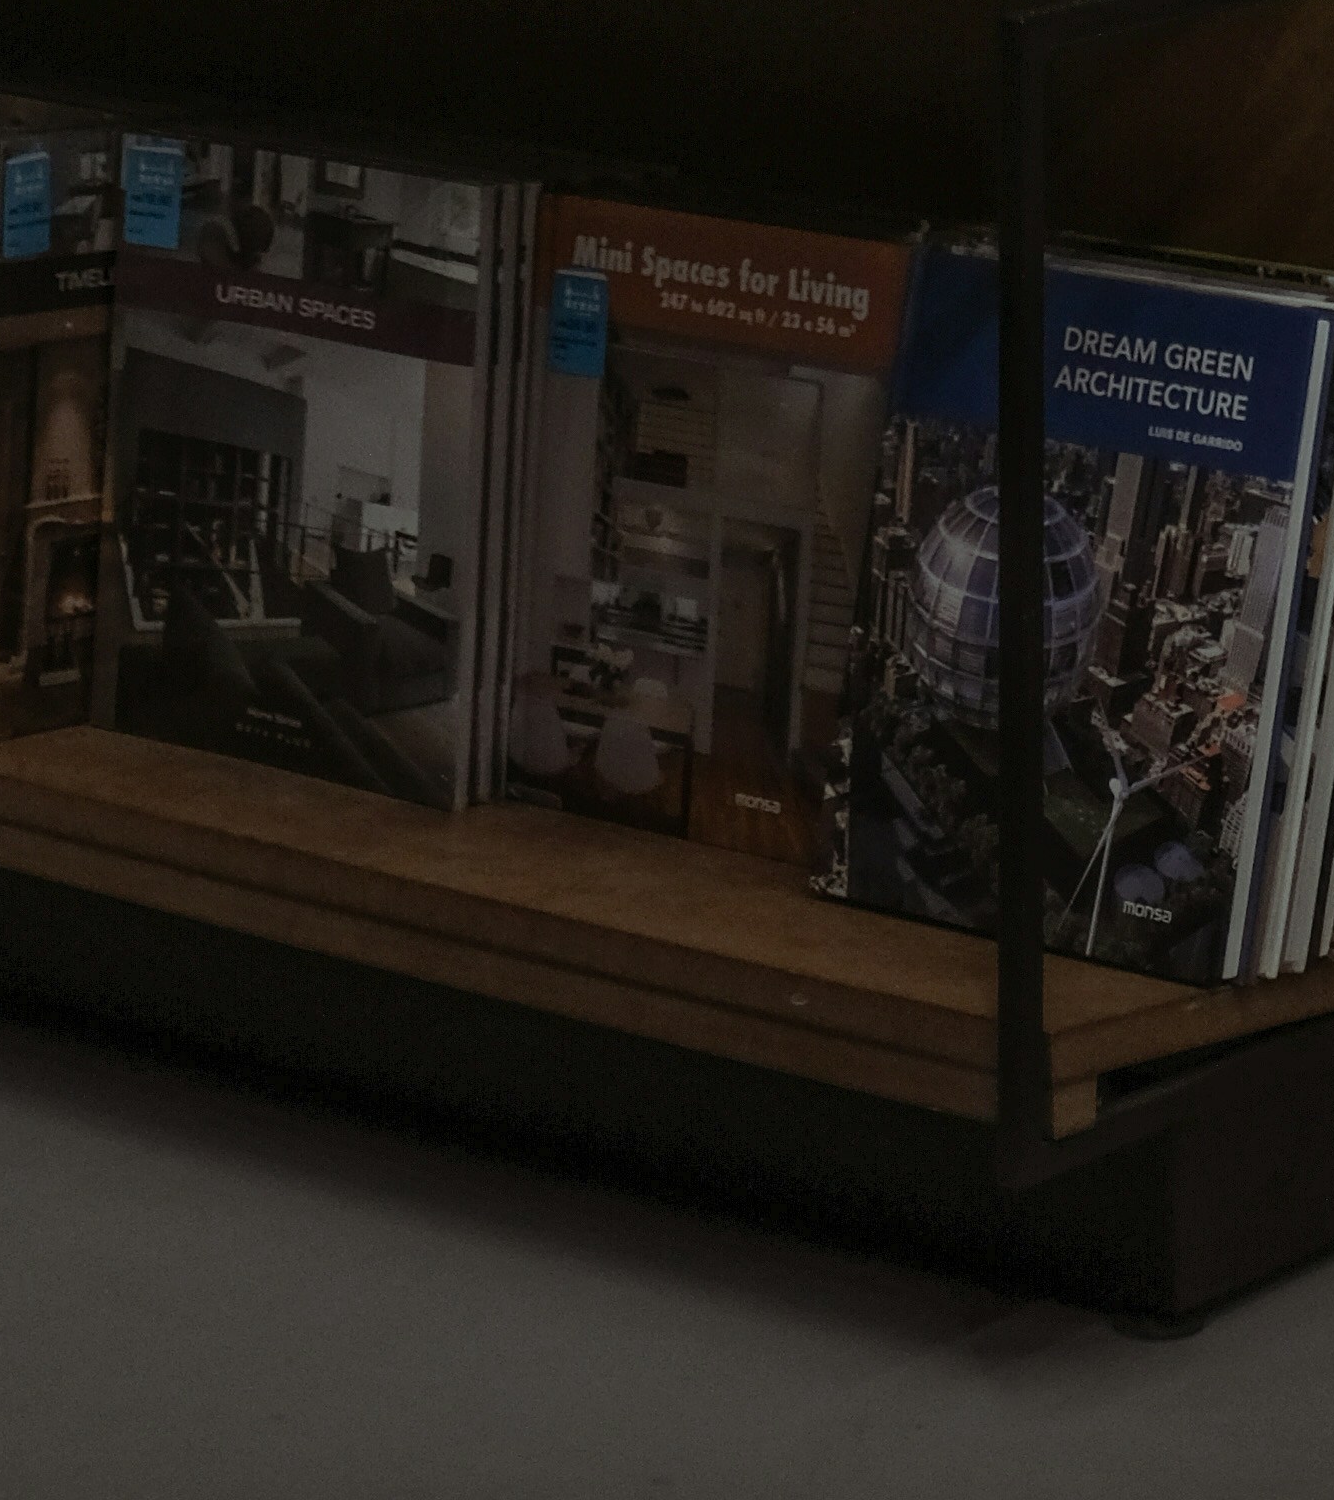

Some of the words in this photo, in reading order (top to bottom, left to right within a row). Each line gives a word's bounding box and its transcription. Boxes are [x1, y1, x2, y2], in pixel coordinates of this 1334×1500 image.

[55, 269, 114, 295] TIMEL
[572, 235, 634, 274] Mini
[640, 245, 730, 289] Spaces
[739, 257, 780, 296] for
[787, 268, 870, 321] Living
[215, 281, 294, 318] URBAN
[297, 295, 376, 330] SPACES
[1063, 325, 1157, 367] DREAM
[1162, 340, 1256, 383] GREEN
[1054, 365, 1249, 422] ARCHITECTURE
[1175, 428, 1190, 445] DE
[1121, 898, 1174, 925] monsa
